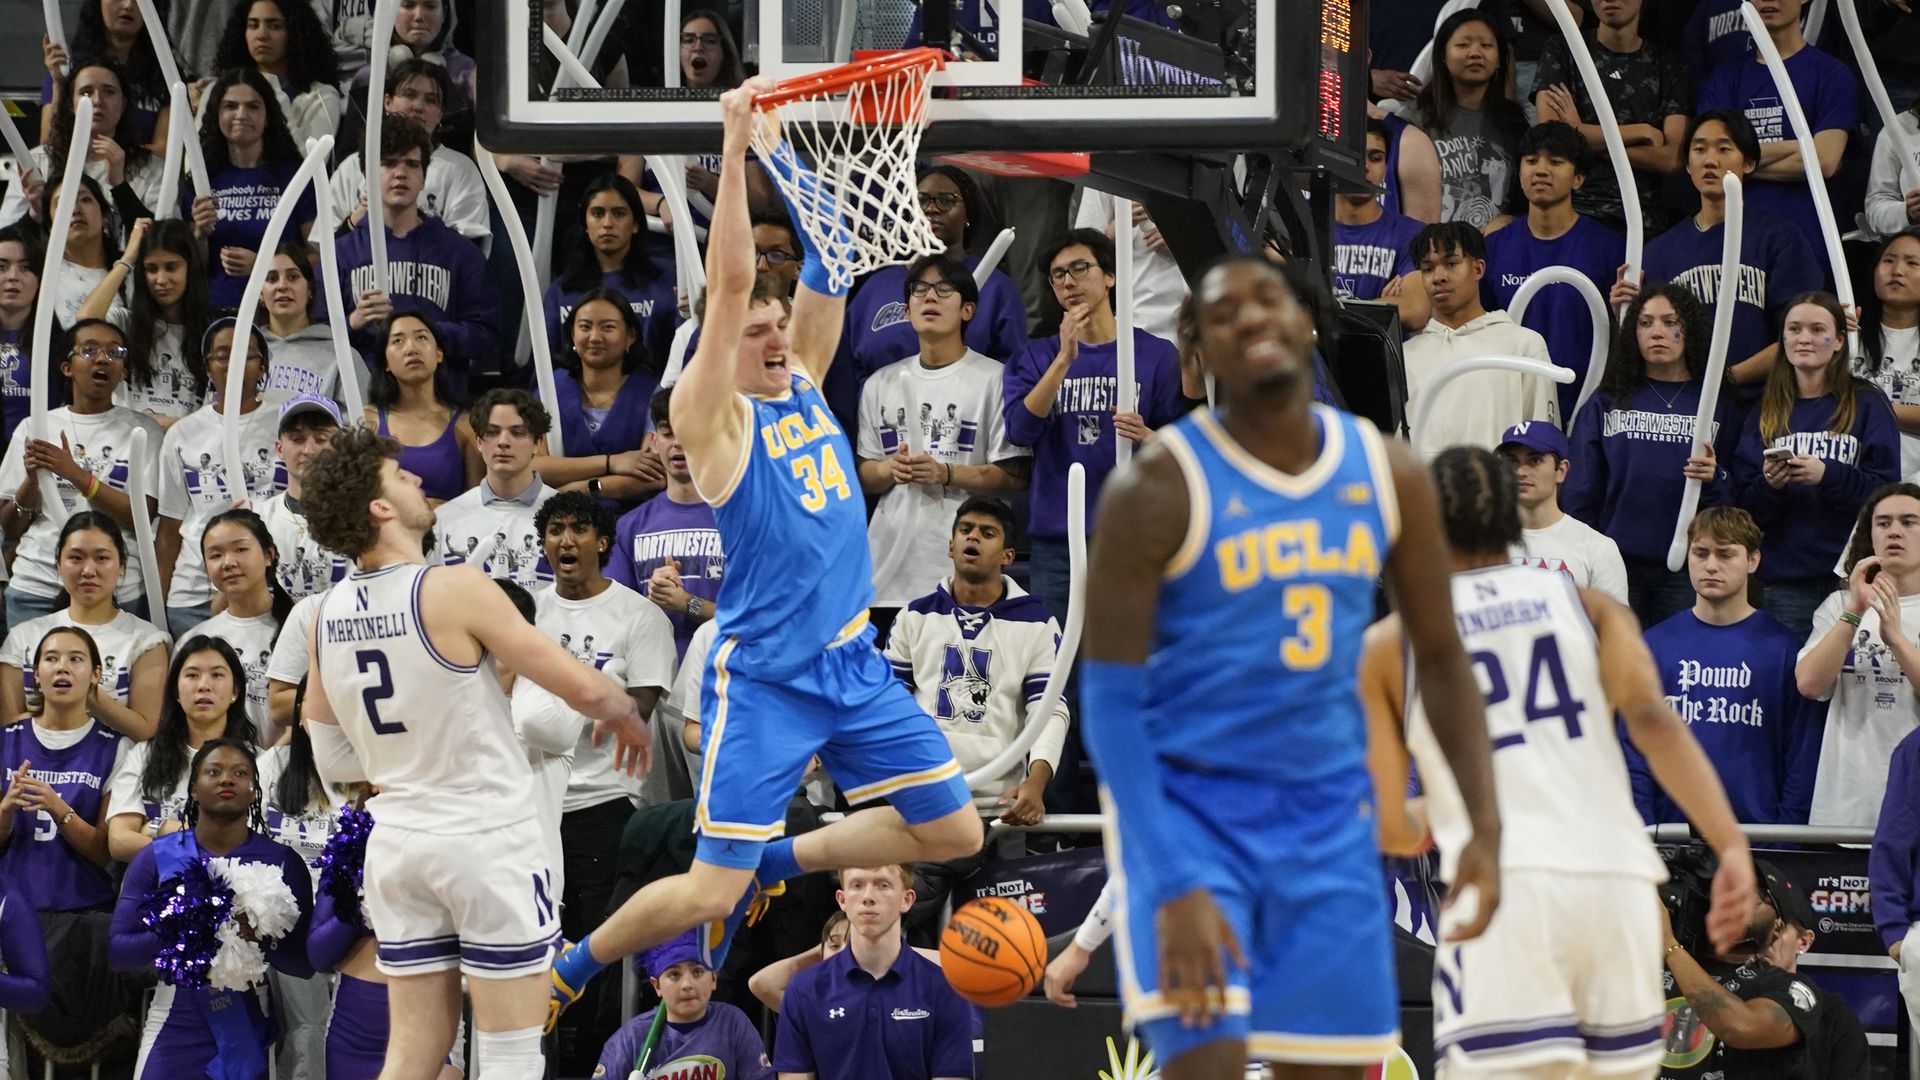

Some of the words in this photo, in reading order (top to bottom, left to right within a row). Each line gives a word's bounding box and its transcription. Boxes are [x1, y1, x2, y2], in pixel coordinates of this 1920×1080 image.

[1755, 124, 1783, 137] ELSH
[1434, 136, 1471, 157] Don't
[1440, 150, 1479, 178] ANIC!
[351, 261, 451, 312] NORHWESTERN
[761, 404, 841, 459] UCLA
[1513, 421, 1531, 436] N
[1626, 431, 1691, 444] UNIVERSITY
[790, 443, 852, 512] 34
[634, 531, 727, 562] NORTHWESTER
[1215, 518, 1381, 592] UCLA
[356, 586, 368, 611] N
[327, 612, 407, 642] MARTINELLI
[1280, 582, 1333, 672] 3
[1678, 659, 1752, 692] Pound
[355, 649, 408, 735] 2
[1664, 694, 1704, 725] The
[1705, 696, 1764, 727] Rock
[301, 841, 325, 849] BROOK
[532, 868, 553, 927] N
[999, 883, 1023, 894] NOT
[1025, 882, 1034, 891] A
[1843, 879, 1867, 888] NOT
[1809, 890, 1871, 913] GAM
